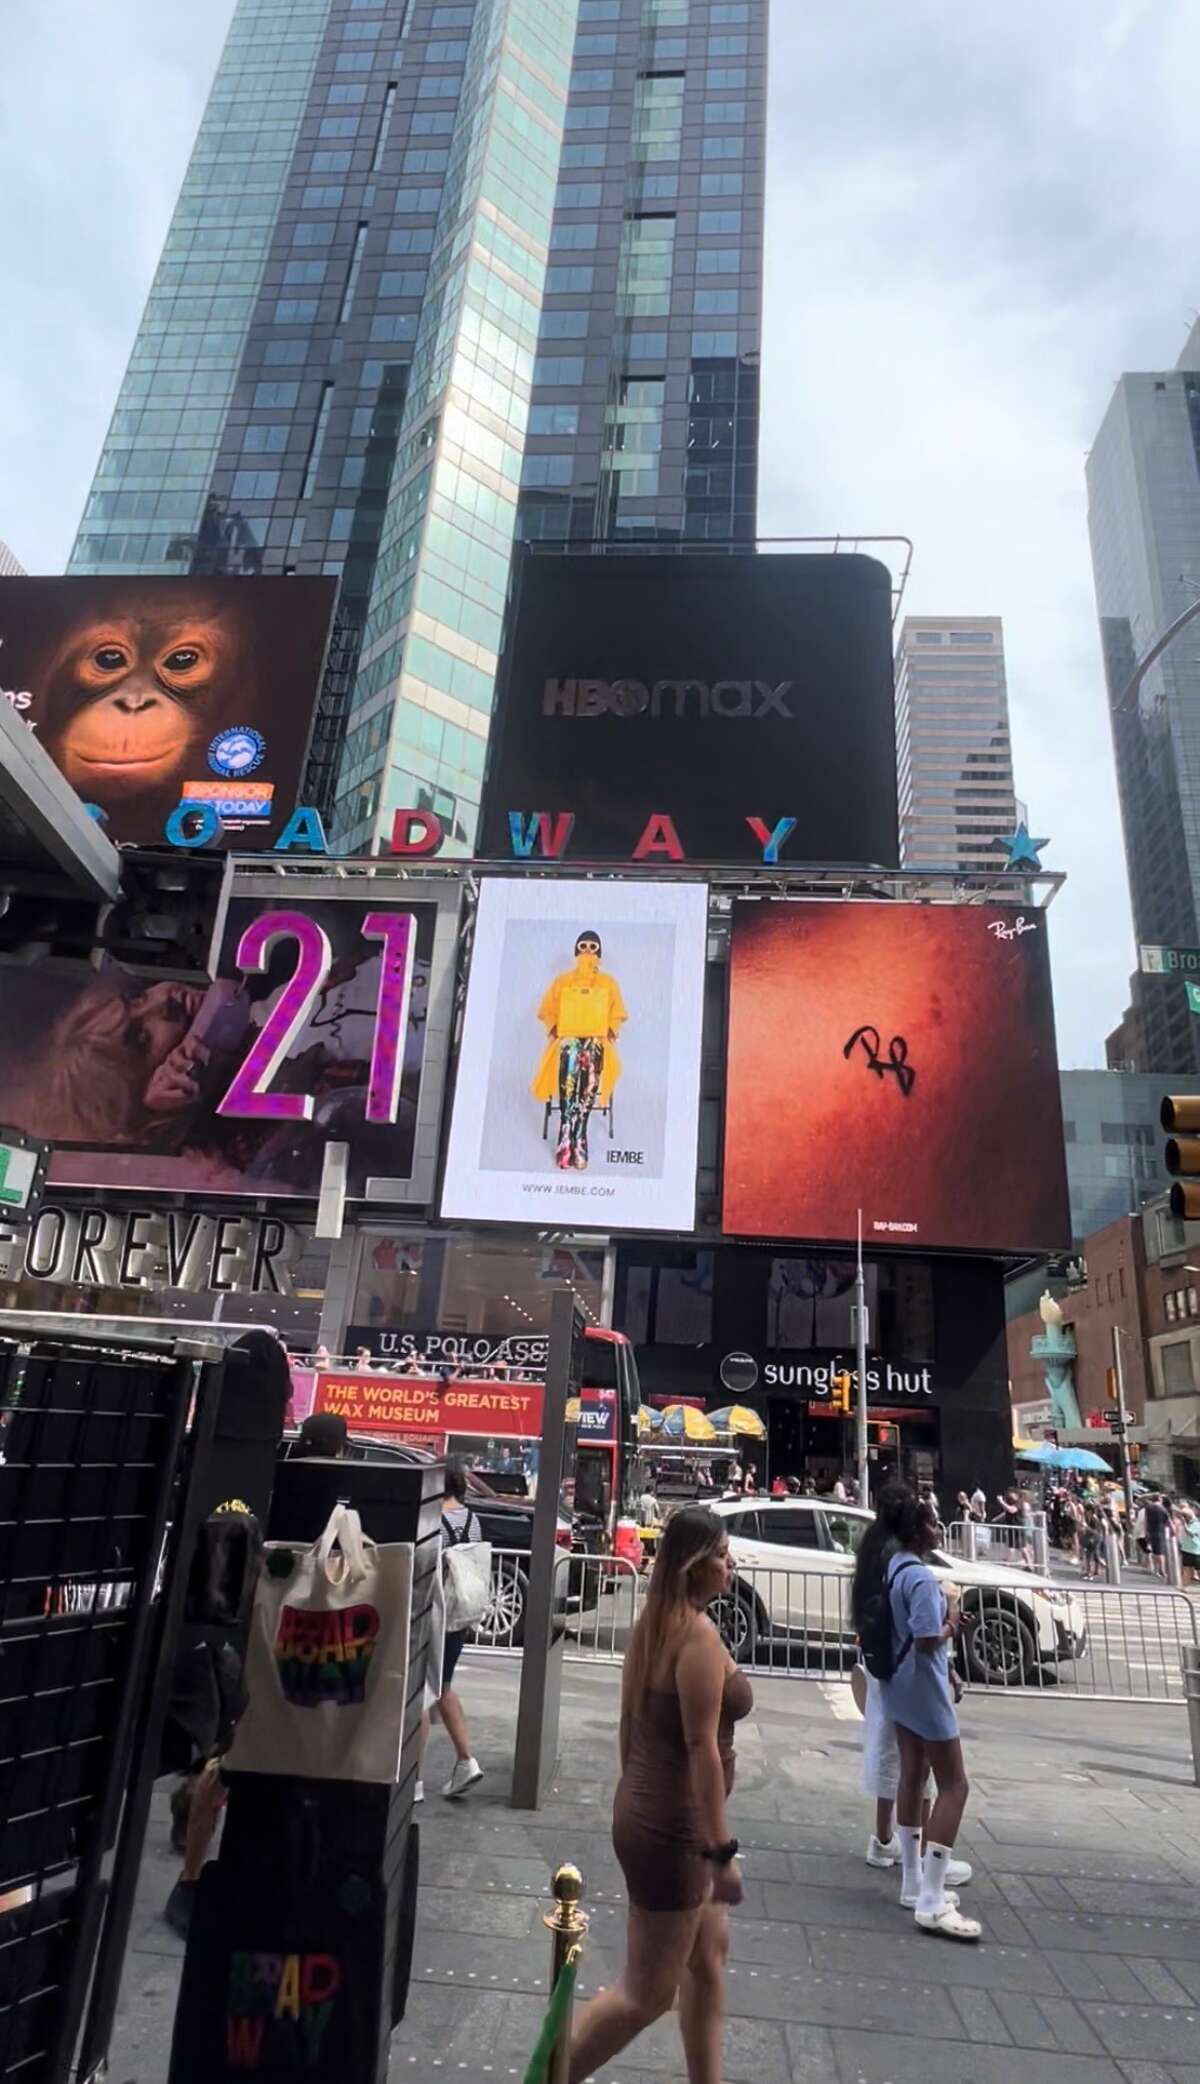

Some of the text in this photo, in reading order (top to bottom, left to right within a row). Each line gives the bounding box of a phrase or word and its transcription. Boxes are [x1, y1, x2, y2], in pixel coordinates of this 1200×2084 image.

[83, 803, 797, 866] OADWAY
[1168, 950, 1200, 970] Bro
[216, 909, 418, 1124] 21
[606, 1150, 644, 1166] IEMBE
[522, 1183, 615, 1198] WWW.IEMBE.COM
[426, 1336, 491, 1358] POLO
[495, 1341, 550, 1363] ASS
[886, 1363, 933, 1394] hut
[326, 1384, 531, 1412] THE WORLD'S GREATEST
[323, 1403, 440, 1423] WAX MUSEUM
